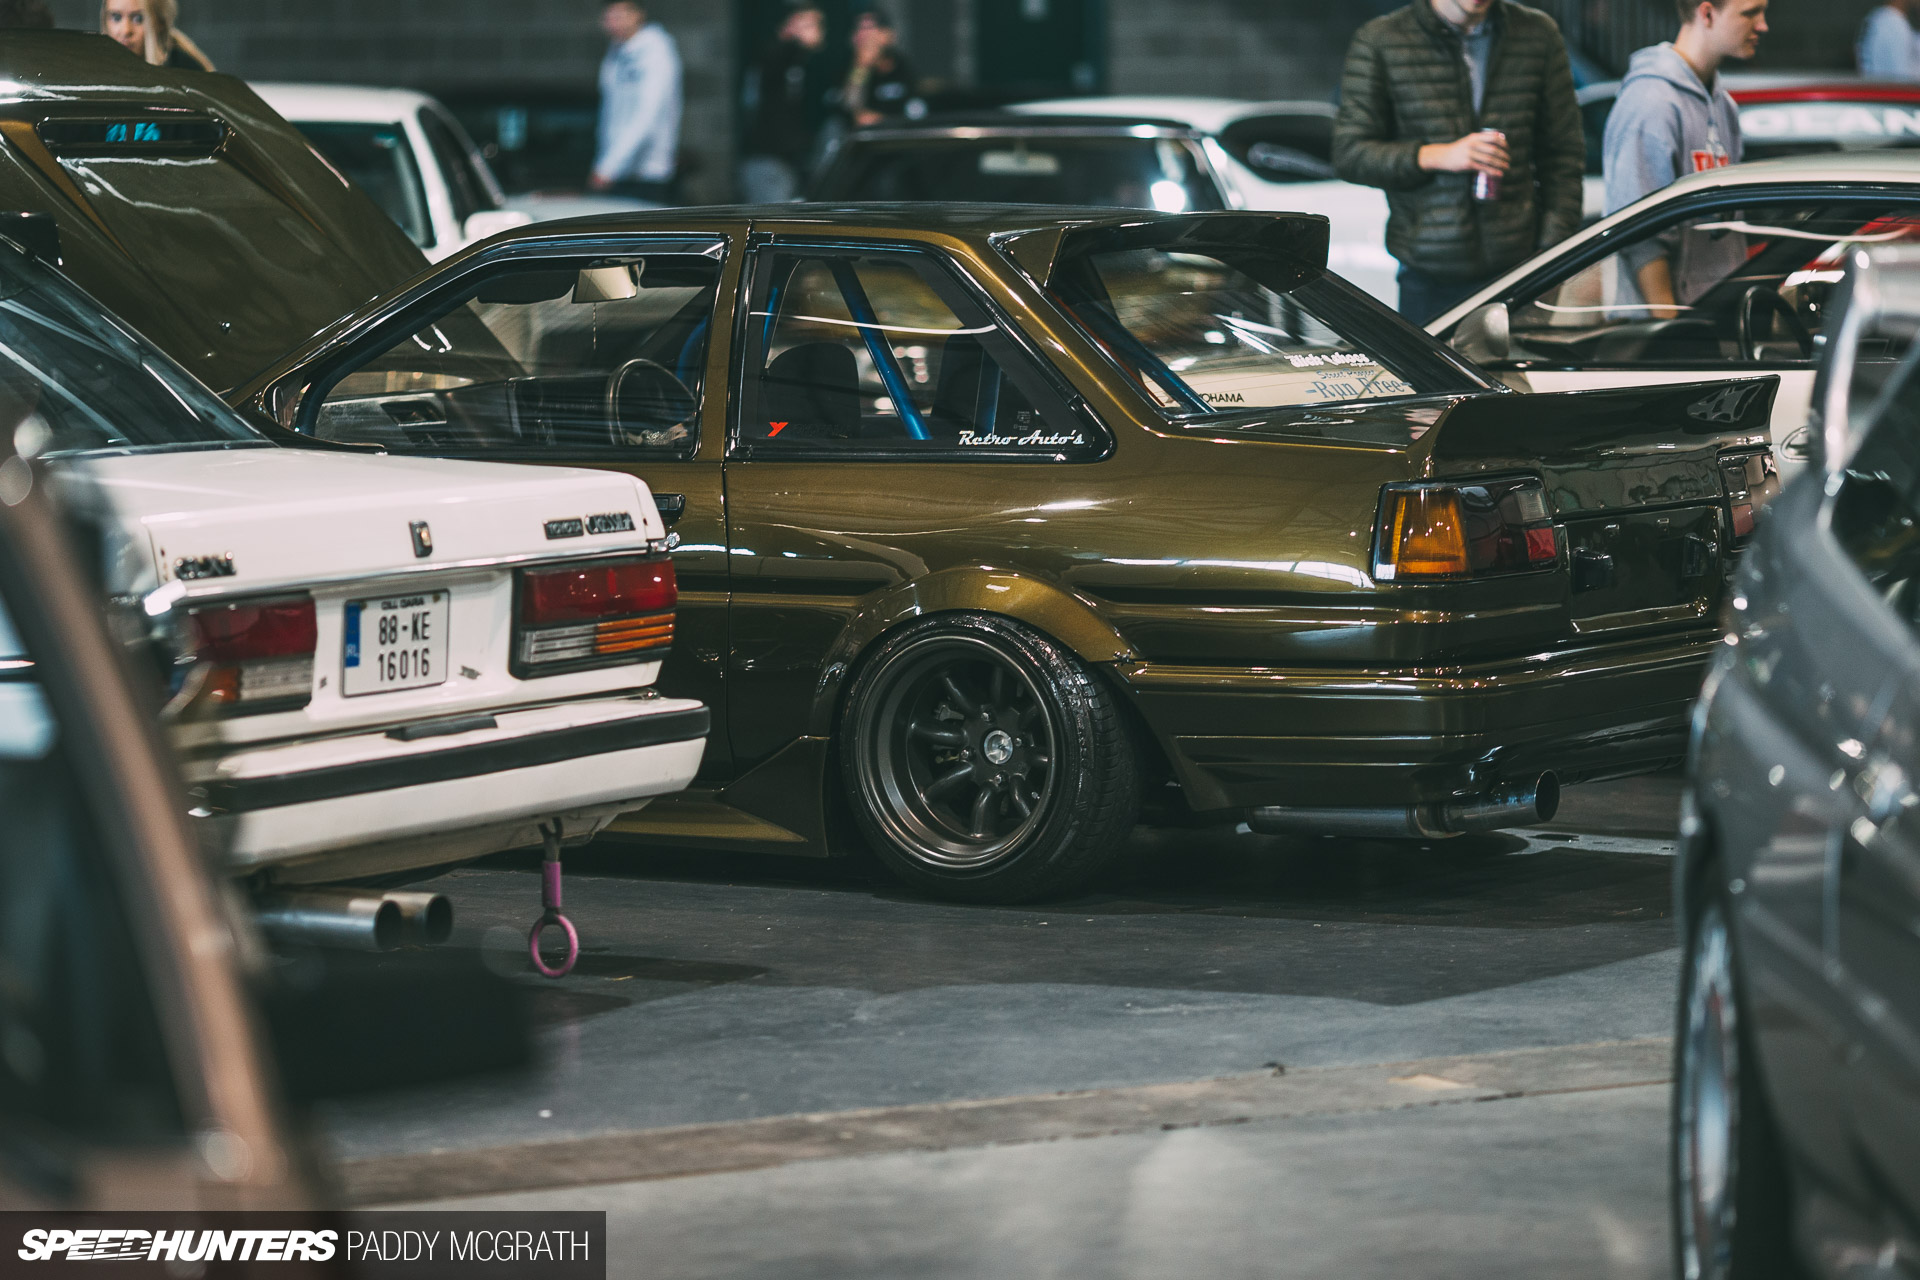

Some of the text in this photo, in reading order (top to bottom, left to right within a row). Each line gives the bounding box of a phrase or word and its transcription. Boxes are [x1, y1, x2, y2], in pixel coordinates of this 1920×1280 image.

[1199, 392, 1245, 404] OHAMA
[958, 429, 1085, 446] Retro Auto's
[544, 519, 584, 538] TOYOTA
[378, 610, 431, 646] 88-KE
[377, 647, 430, 682] 16016
